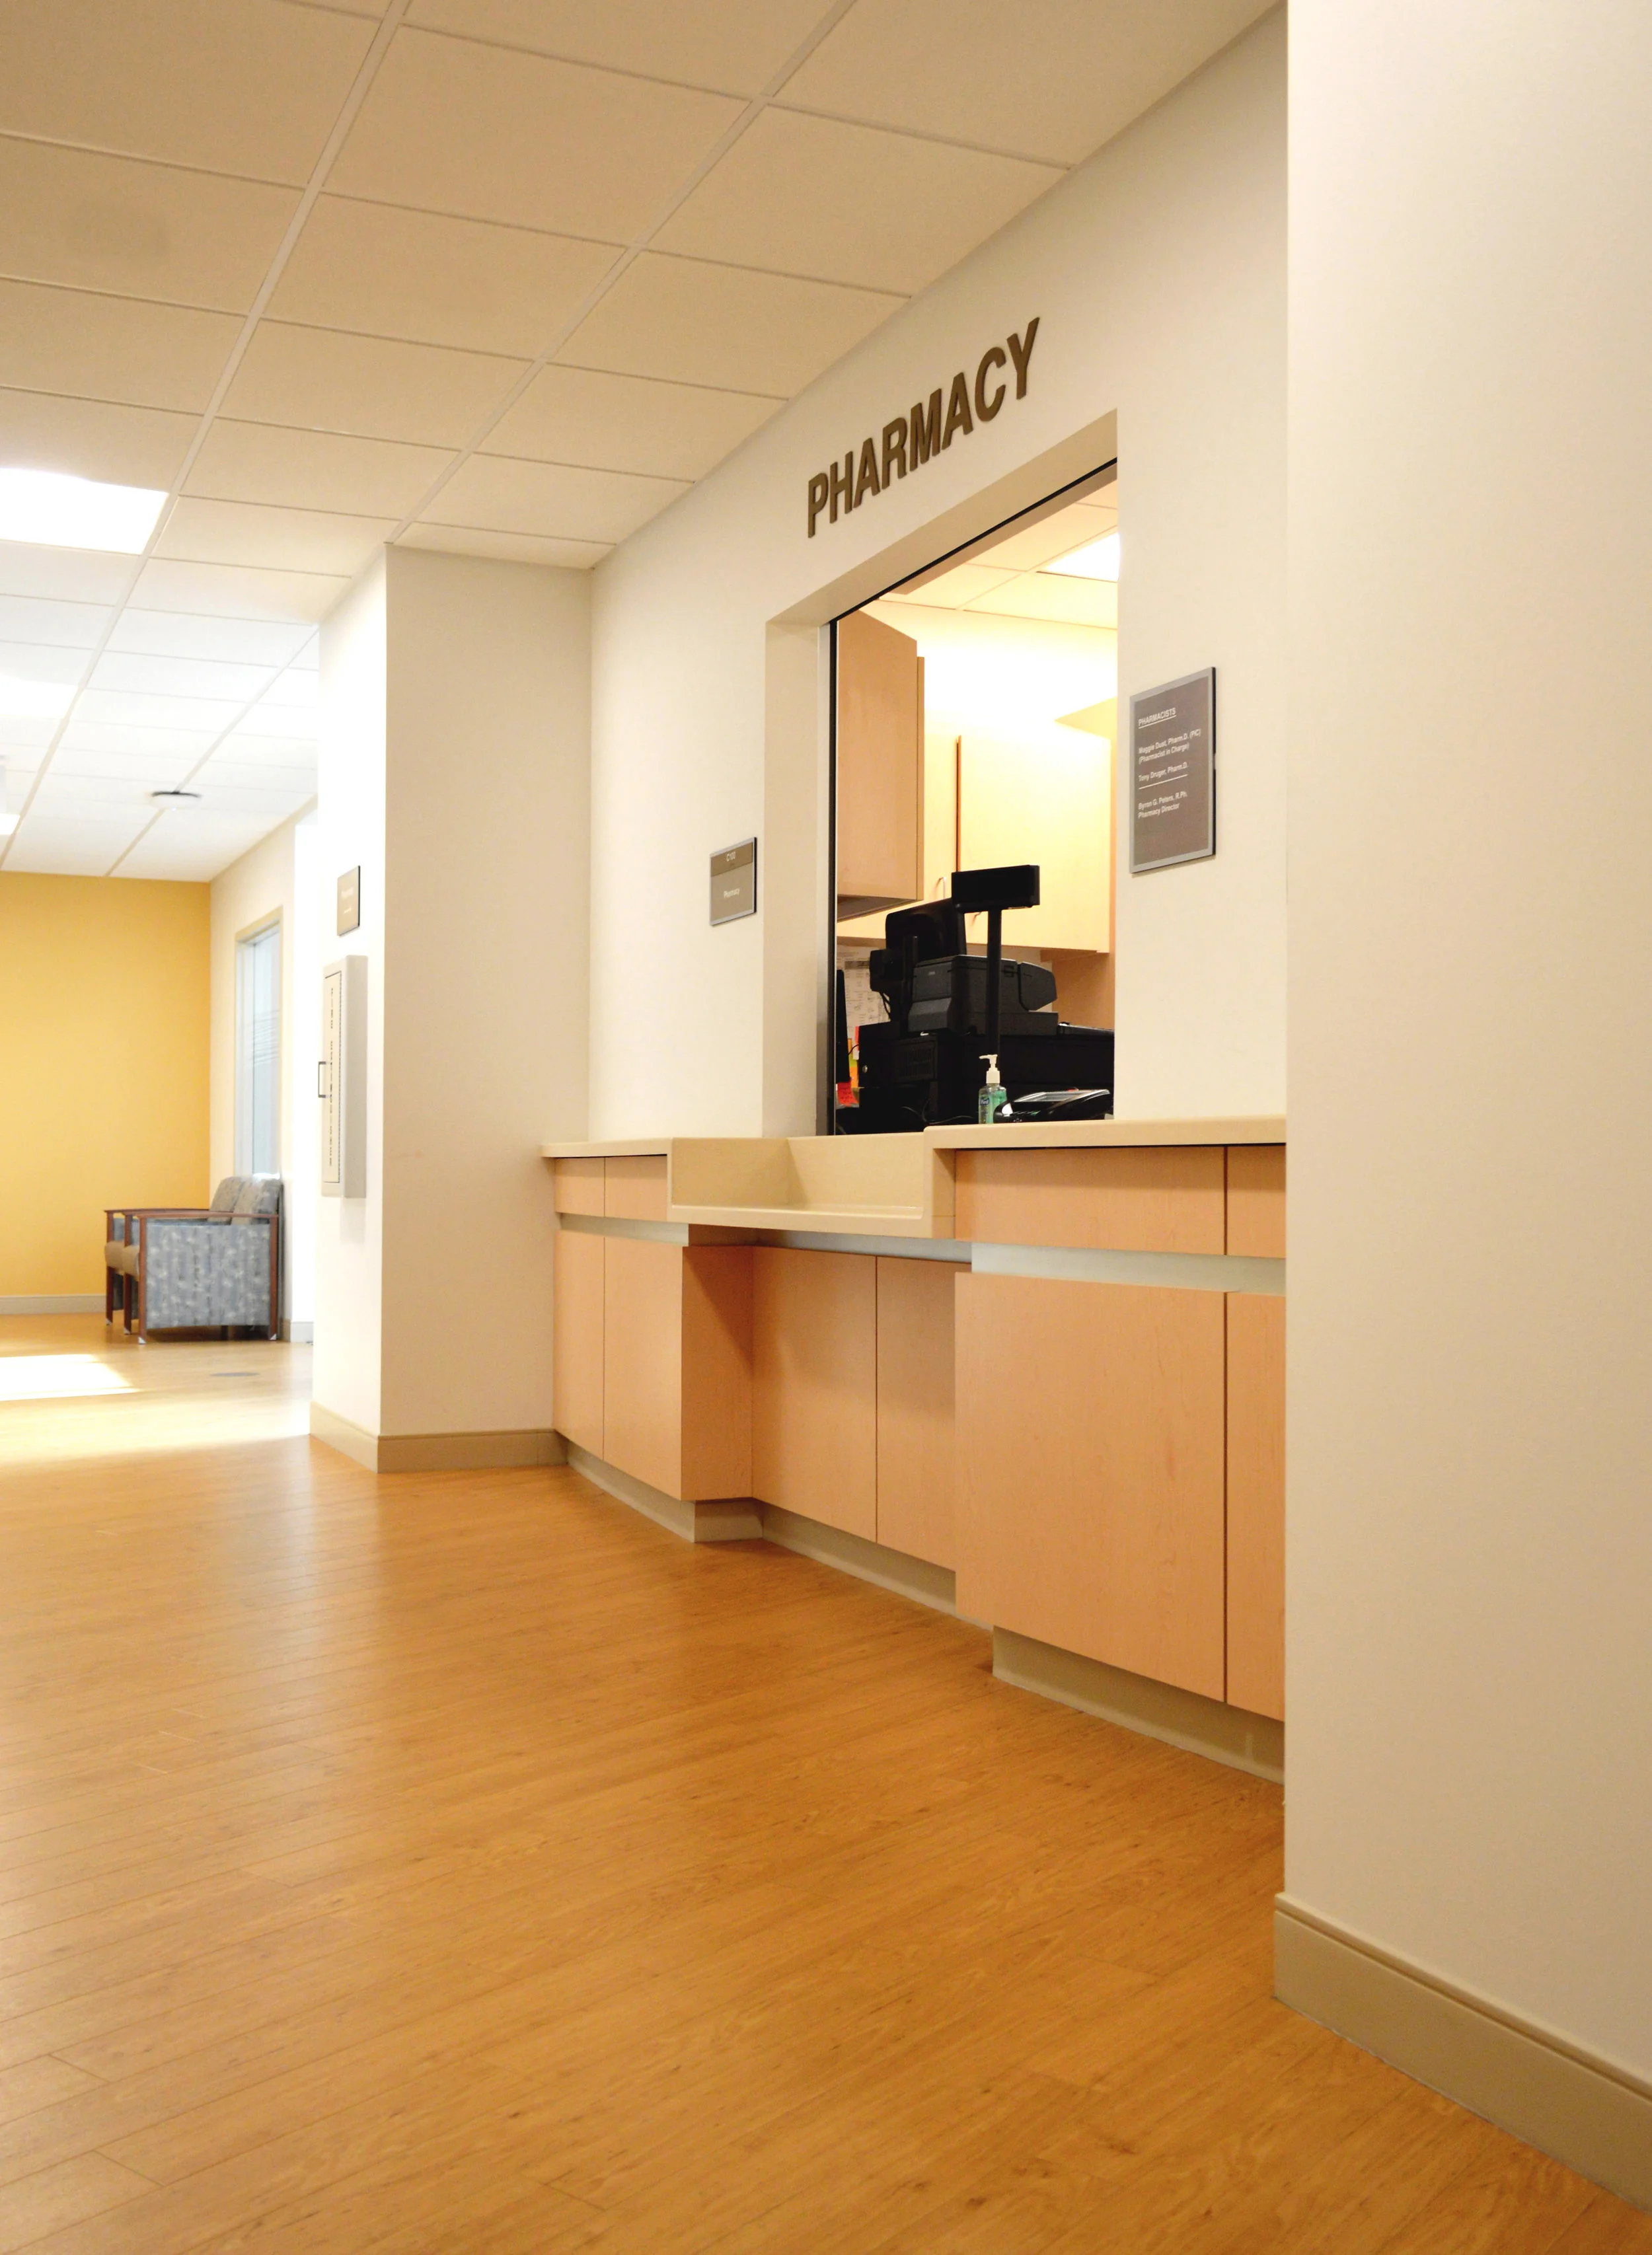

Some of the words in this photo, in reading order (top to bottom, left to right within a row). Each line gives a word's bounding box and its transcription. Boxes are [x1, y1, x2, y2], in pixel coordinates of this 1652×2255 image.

[808, 316, 1040, 538] PHARMACY
[1138, 707, 1176, 726] PHARMACISTS
[1171, 742, 1190, 753] Charge)
[1139, 774, 1150, 782] Tony
[1138, 808, 1161, 820] Pharmacy
[1161, 803, 1180, 814] Director
